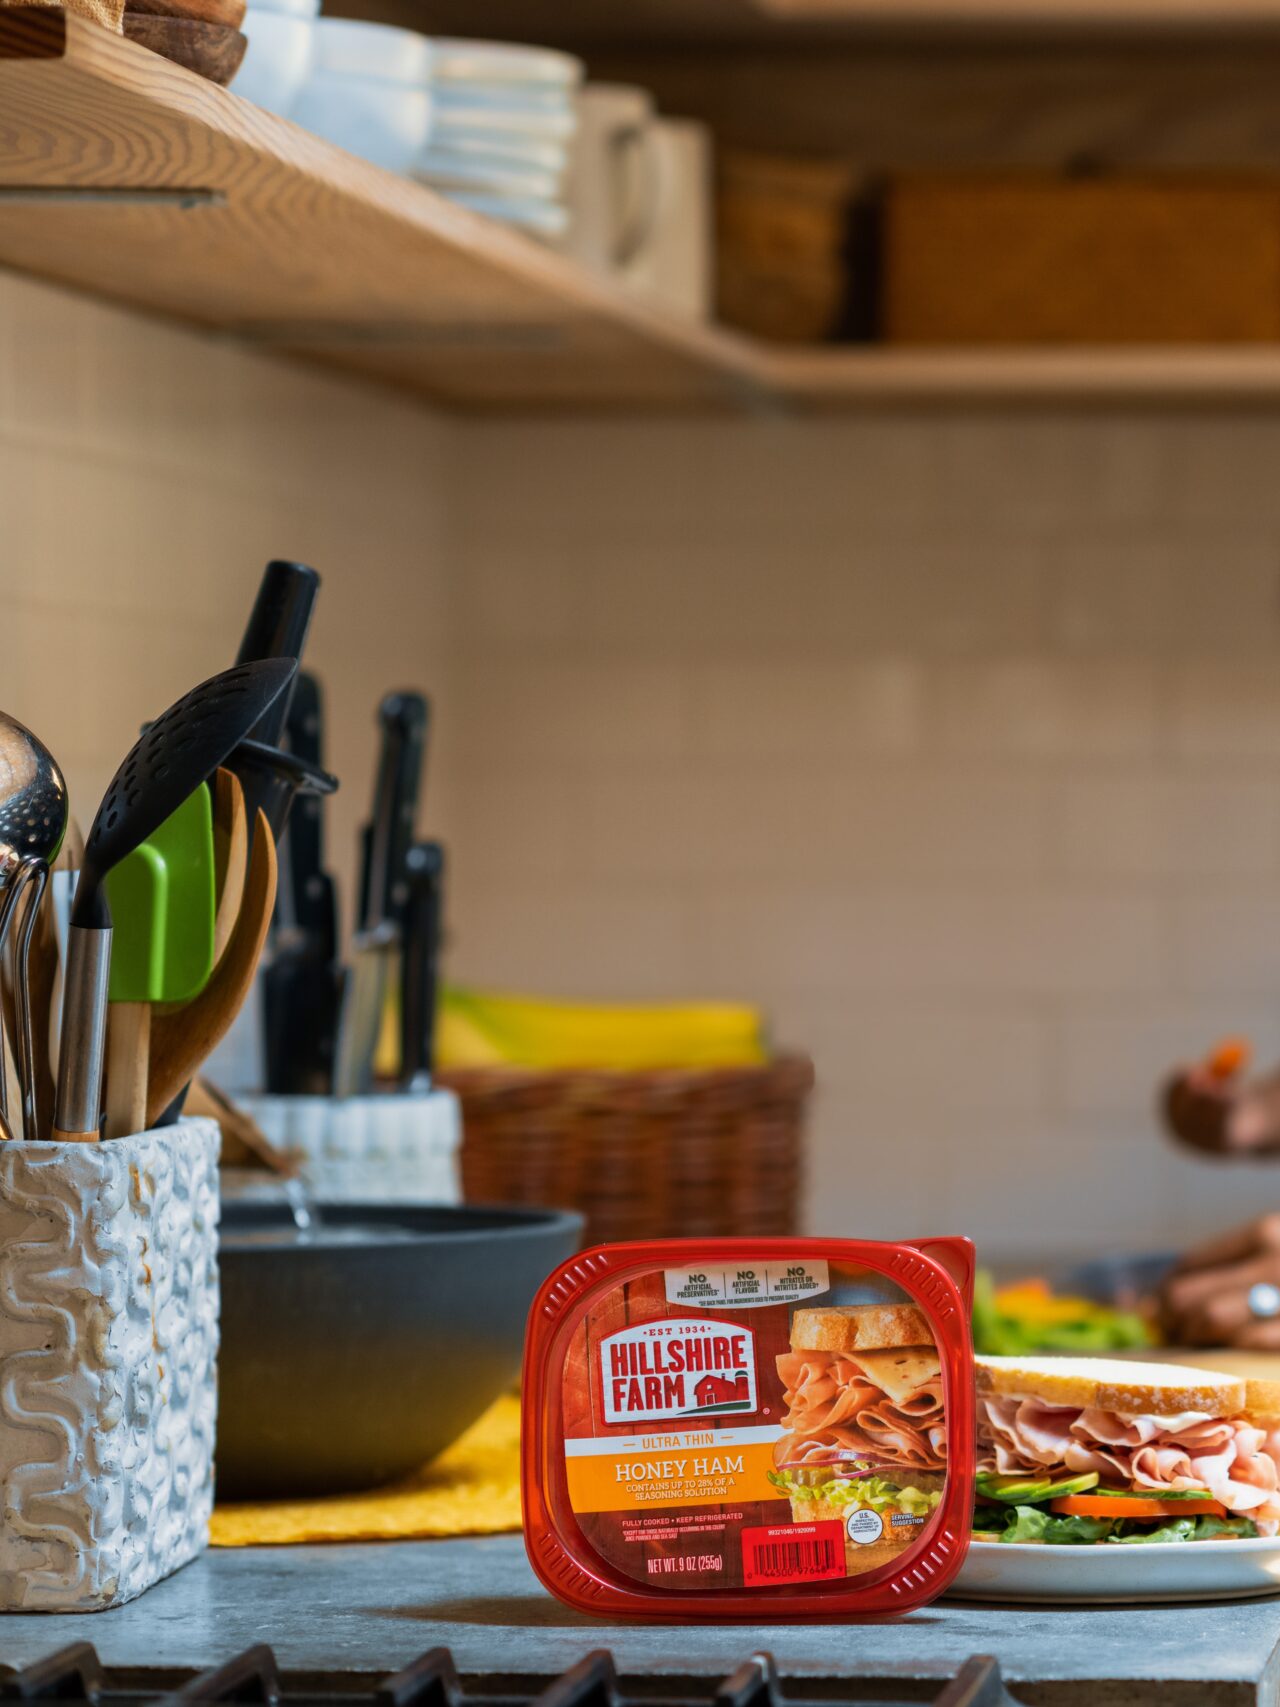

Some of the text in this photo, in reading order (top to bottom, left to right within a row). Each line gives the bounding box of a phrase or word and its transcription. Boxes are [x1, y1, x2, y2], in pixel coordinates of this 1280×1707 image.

[737, 1270, 756, 1280] NO
[787, 1267, 806, 1277] NO
[688, 1274, 707, 1284] NO
[732, 1280, 760, 1288] ARTIFICIAL
[684, 1283, 713, 1292] ARTIFICIAL
[735, 1286, 759, 1295] FLAVORS
[774, 1283, 798, 1292] NITRITES
[649, 1325, 706, 1337] EST 1934
[610, 1335, 748, 1377] HILLSHIRE
[612, 1374, 686, 1412] FARM
[642, 1433, 715, 1449] ULTRA THIN
[615, 1455, 745, 1482] HONEY HAM
[626, 1477, 736, 1493] CONTAINS UP TO 28% OF A
[635, 1486, 728, 1501] SEASONING SOLUTION
[622, 1512, 743, 1527] FULLY COOKED KEEP REFRIGERATED
[647, 1554, 723, 1574] NET WT. 9 OZ (255g)
